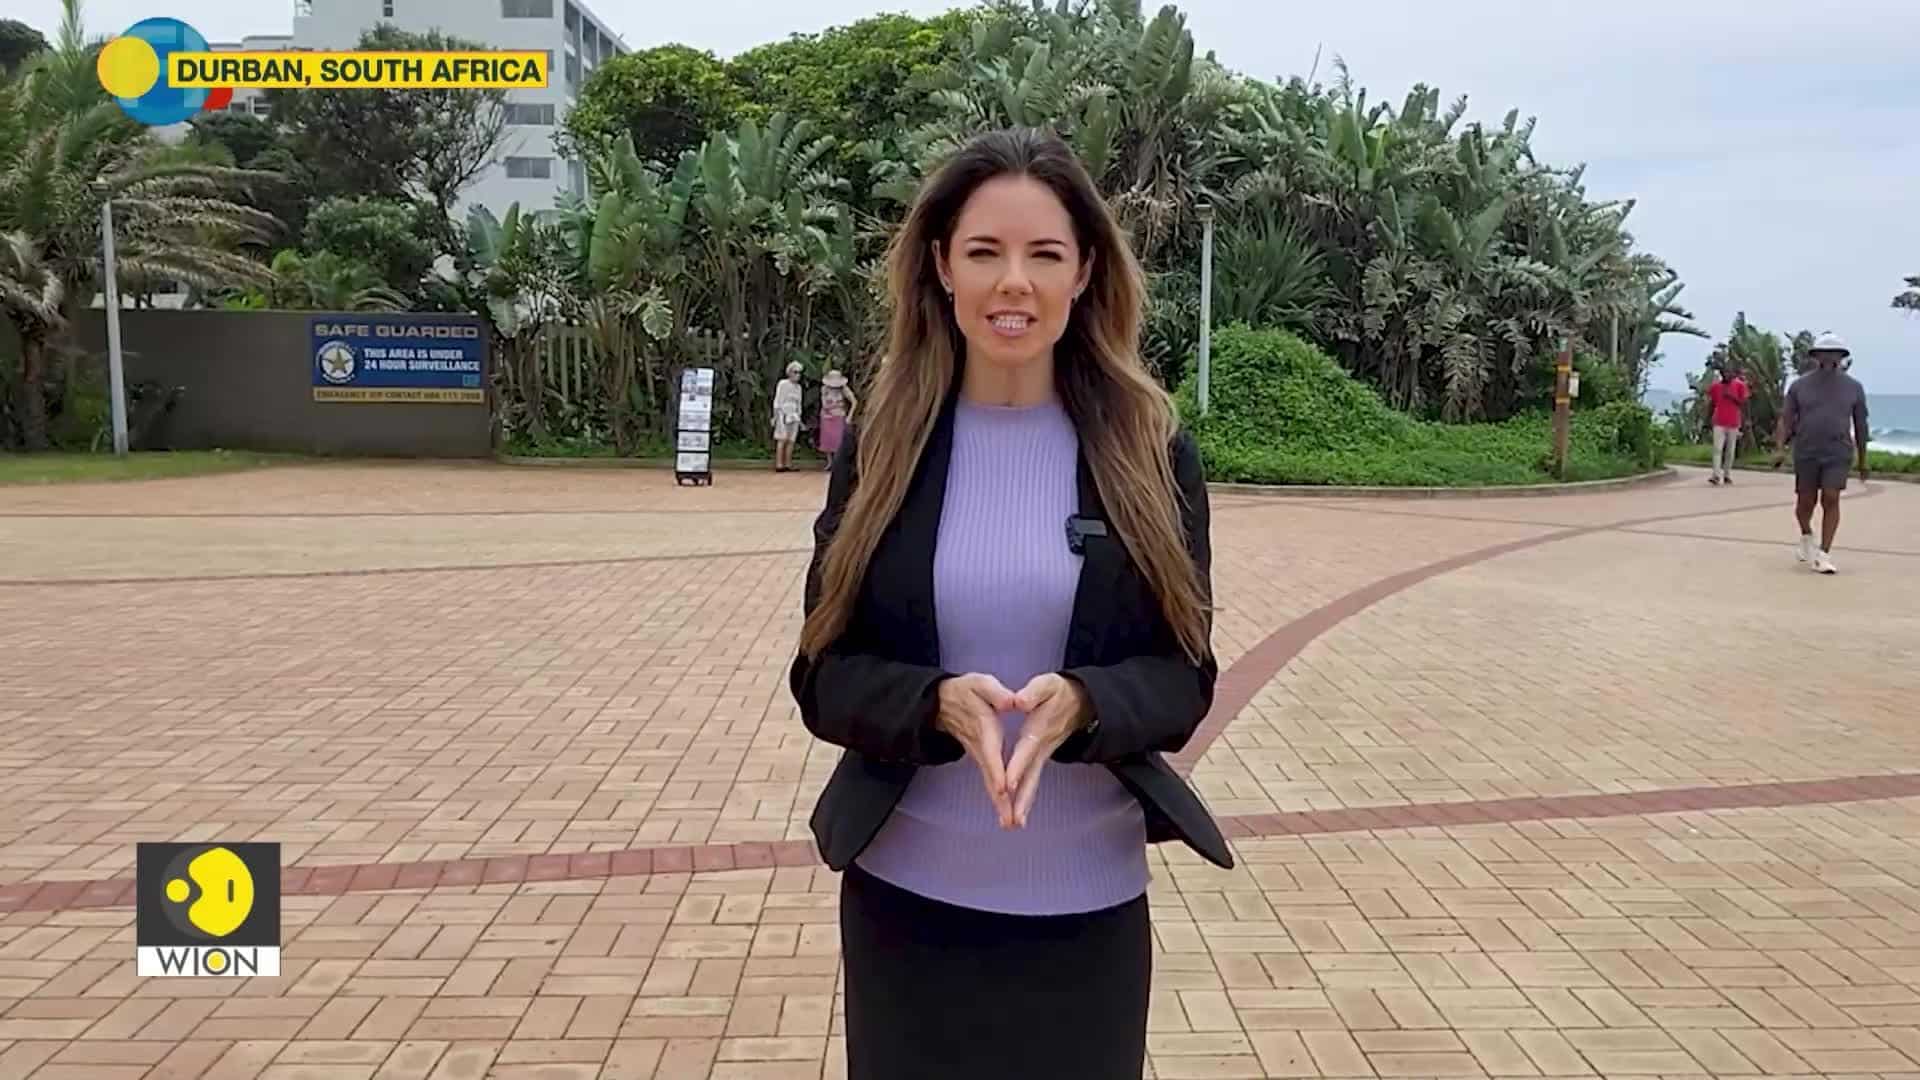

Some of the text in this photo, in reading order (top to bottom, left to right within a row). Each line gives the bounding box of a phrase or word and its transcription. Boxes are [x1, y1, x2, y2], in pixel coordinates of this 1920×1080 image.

[315, 324, 478, 338] SAFE GUARDED
[364, 348, 387, 359] THIS
[388, 348, 415, 359] AREA
[417, 349, 428, 359] IS
[429, 349, 463, 360] UNDER
[364, 360, 480, 372] 24 HOUR SURVEILLANCE
